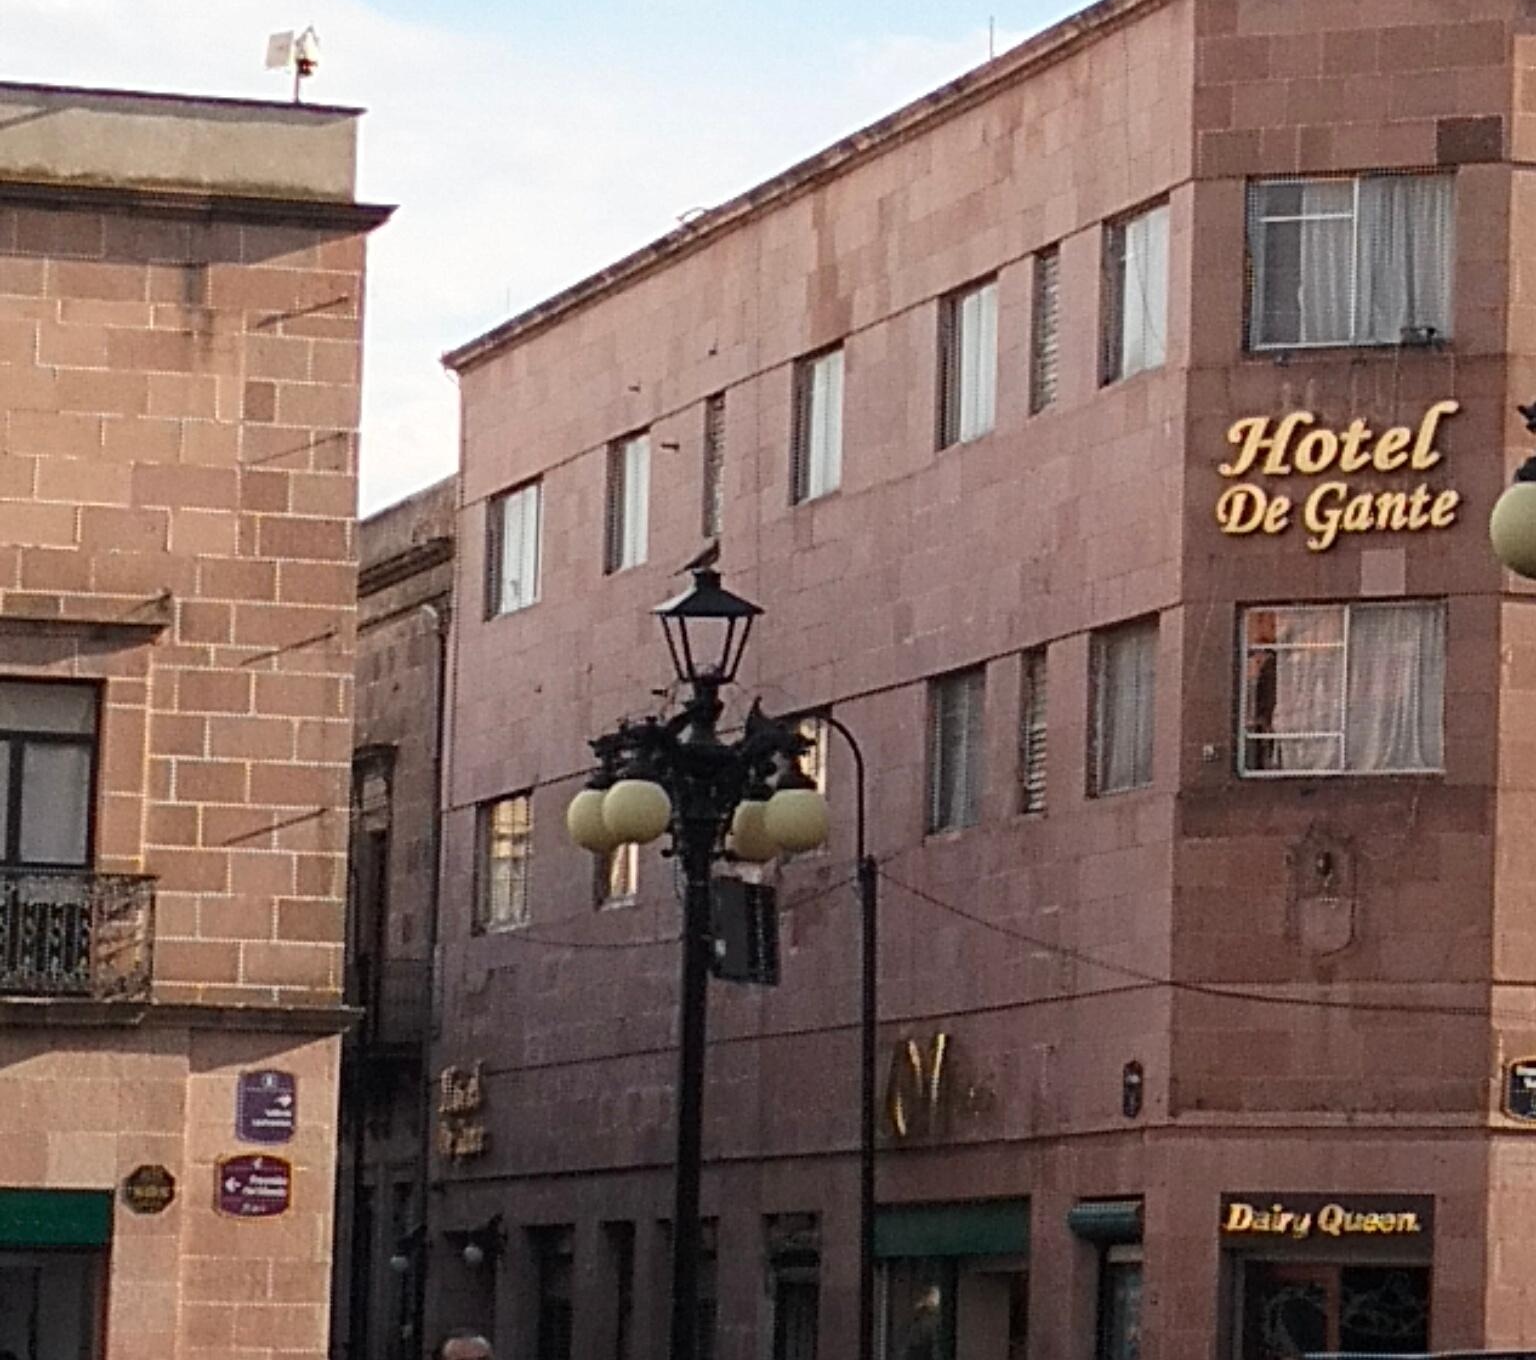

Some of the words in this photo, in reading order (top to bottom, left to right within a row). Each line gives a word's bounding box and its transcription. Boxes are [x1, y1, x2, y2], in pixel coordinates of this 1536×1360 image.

[1217, 400, 1460, 477] Hotel
[1215, 482, 1292, 534] De
[1303, 481, 1460, 551] Gante
[1224, 1203, 1311, 1239] Dairy
